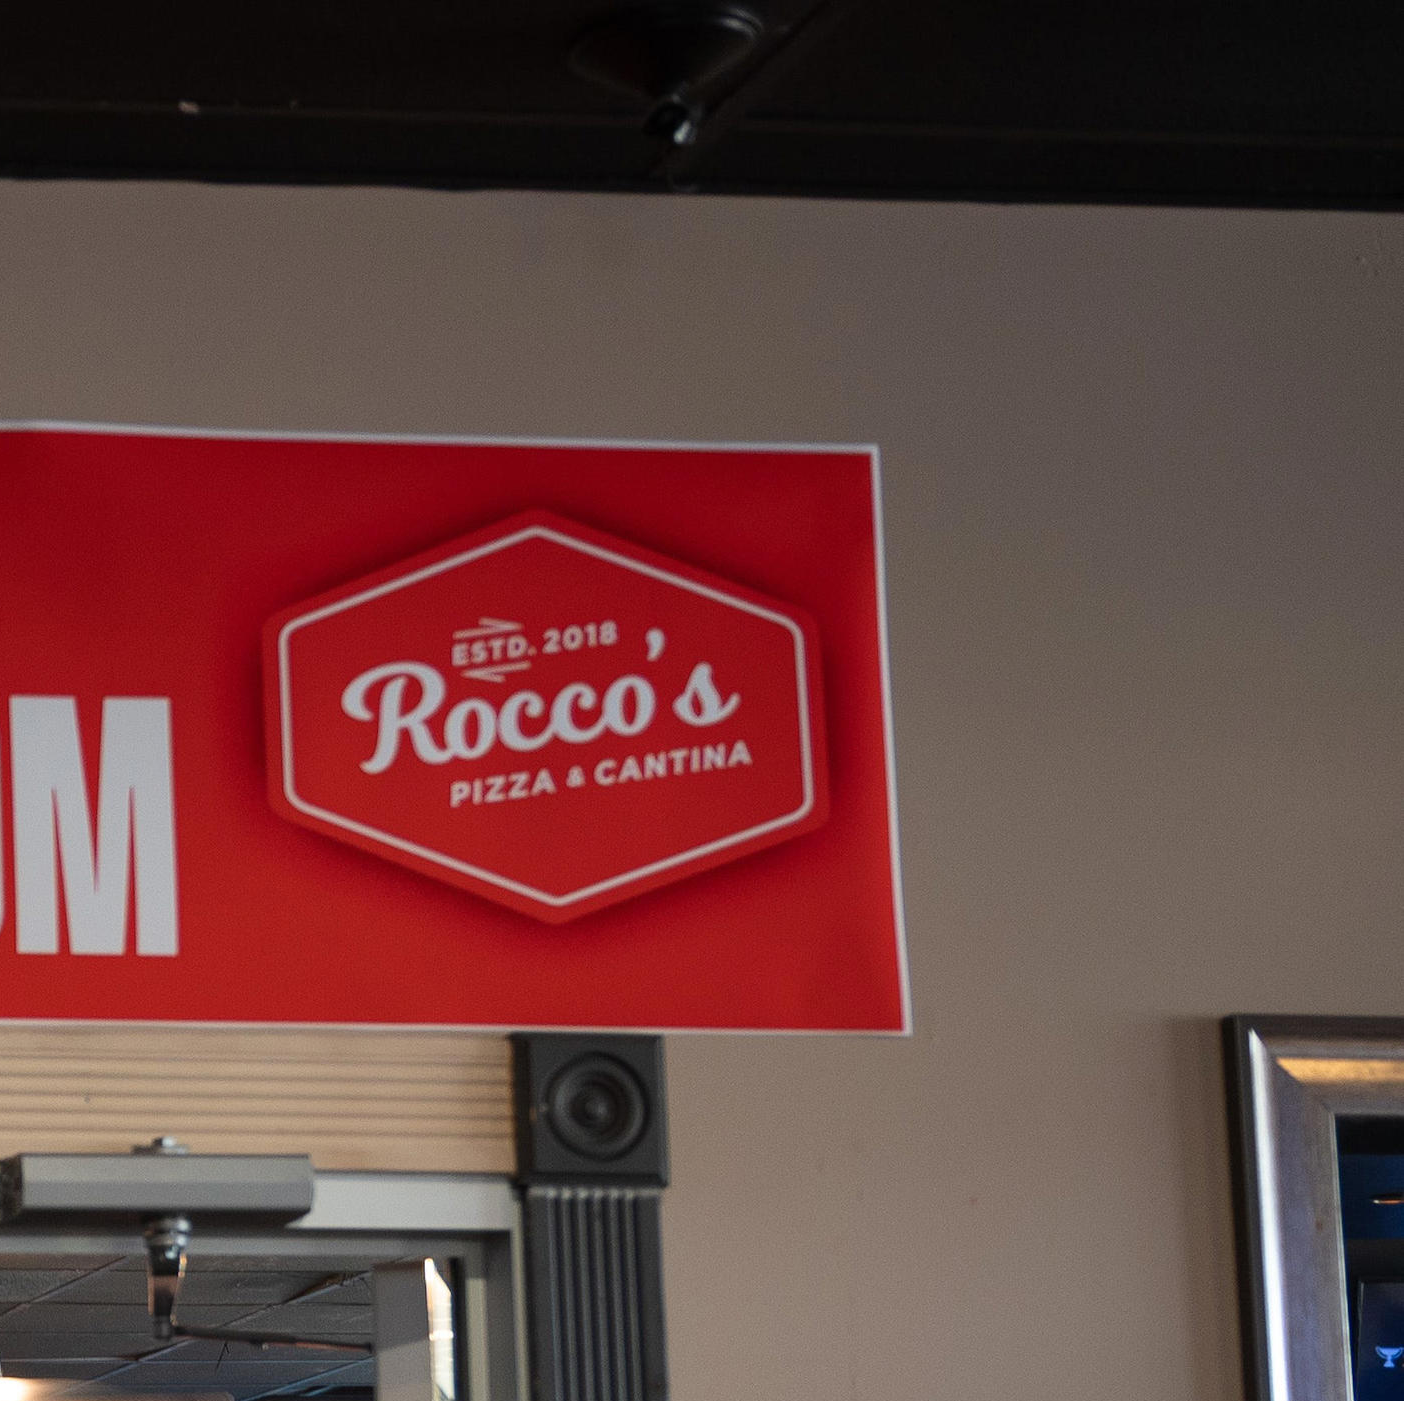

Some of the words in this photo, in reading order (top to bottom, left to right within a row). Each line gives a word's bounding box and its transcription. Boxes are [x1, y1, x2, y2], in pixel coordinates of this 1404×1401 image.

[450, 635, 538, 667] ESTD.
[543, 620, 618, 653] 2018
[340, 626, 741, 775] Rocco's
[449, 767, 556, 808] PIZZA
[566, 767, 584, 790] &
[593, 739, 754, 787] CANTINA
